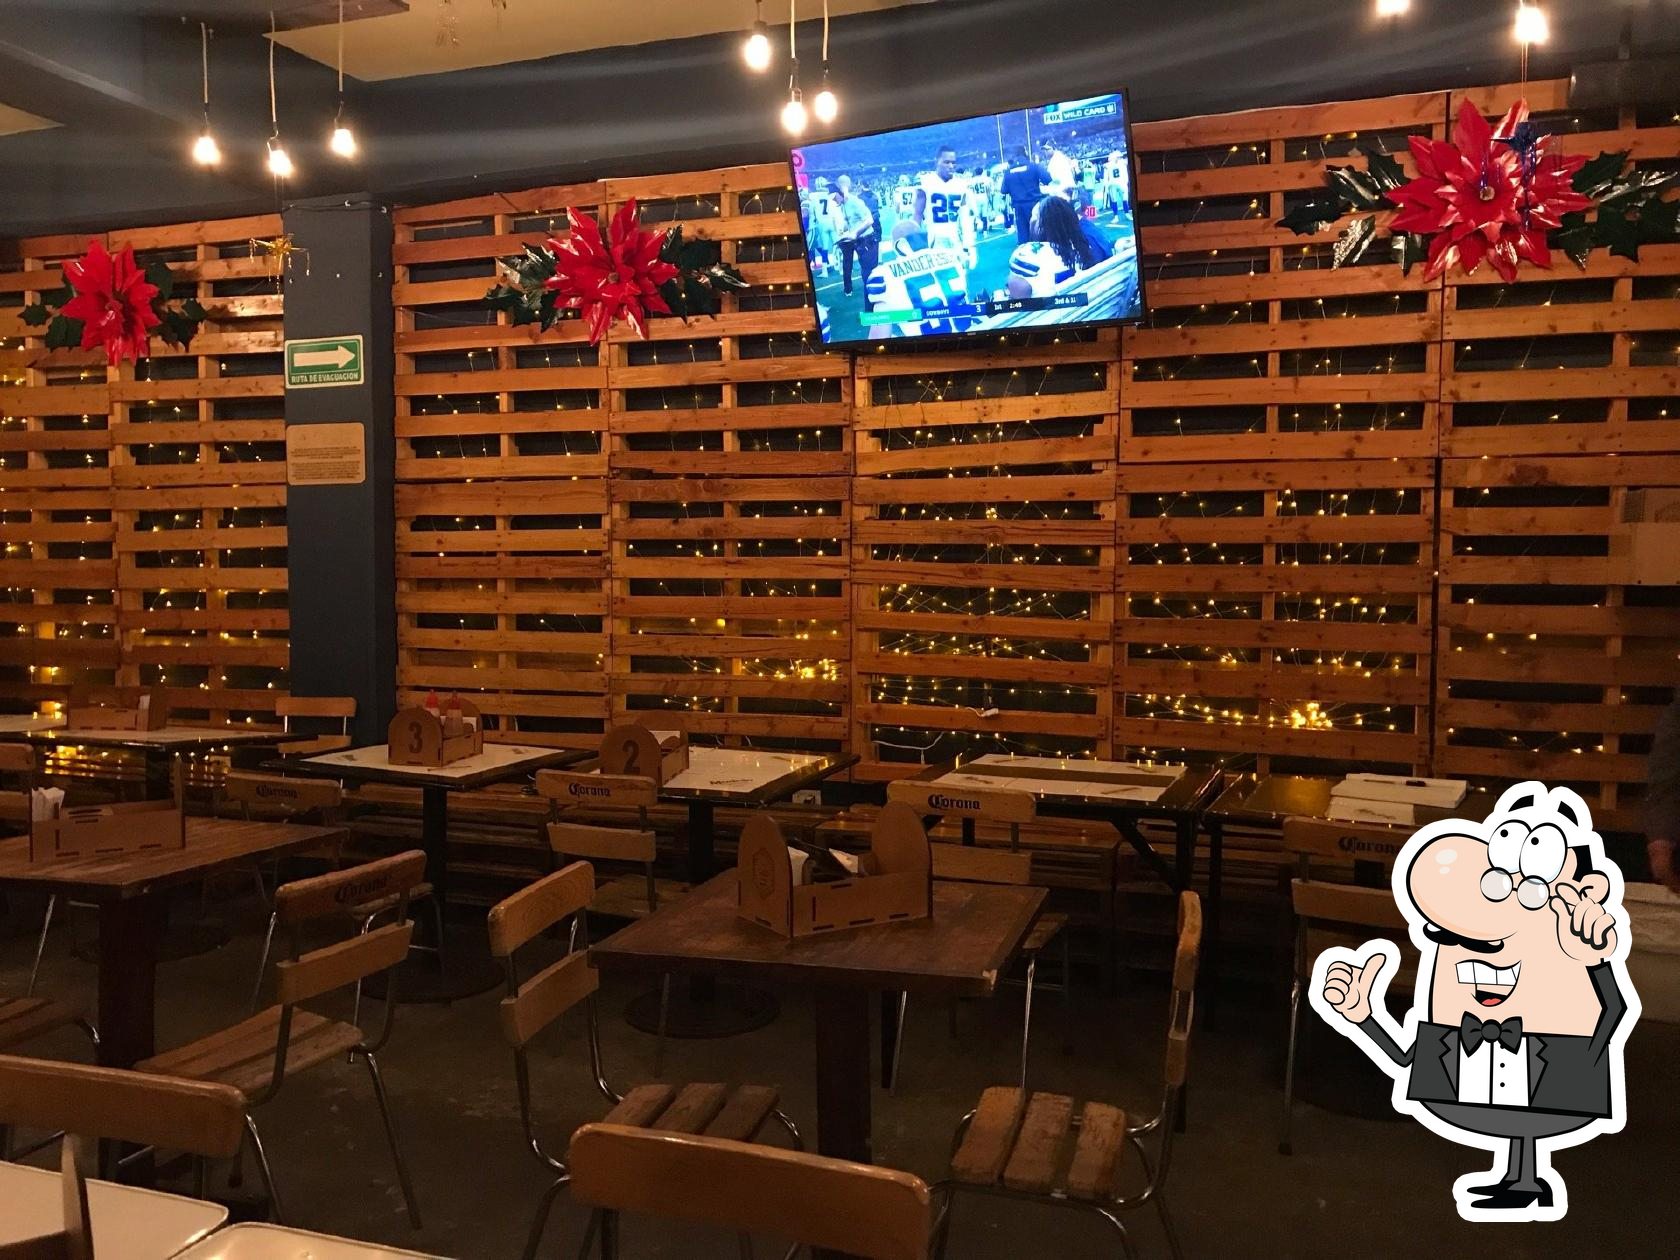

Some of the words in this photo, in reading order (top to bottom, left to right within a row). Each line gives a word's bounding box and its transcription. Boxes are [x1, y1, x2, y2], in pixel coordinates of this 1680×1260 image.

[1045, 113, 1061, 122] FOX
[1063, 109, 1083, 119] WILD
[1084, 106, 1105, 116] CARD
[819, 199, 828, 216] 7
[930, 192, 961, 224] 25
[976, 304, 982, 313] 3
[1054, 297, 1065, 305] 3rd
[291, 374, 308, 383] RUTA
[309, 374, 318, 382] DE
[408, 721, 423, 754] 3
[623, 740, 641, 775] 2
[569, 782, 611, 797] Corona
[928, 793, 981, 811] Corona
